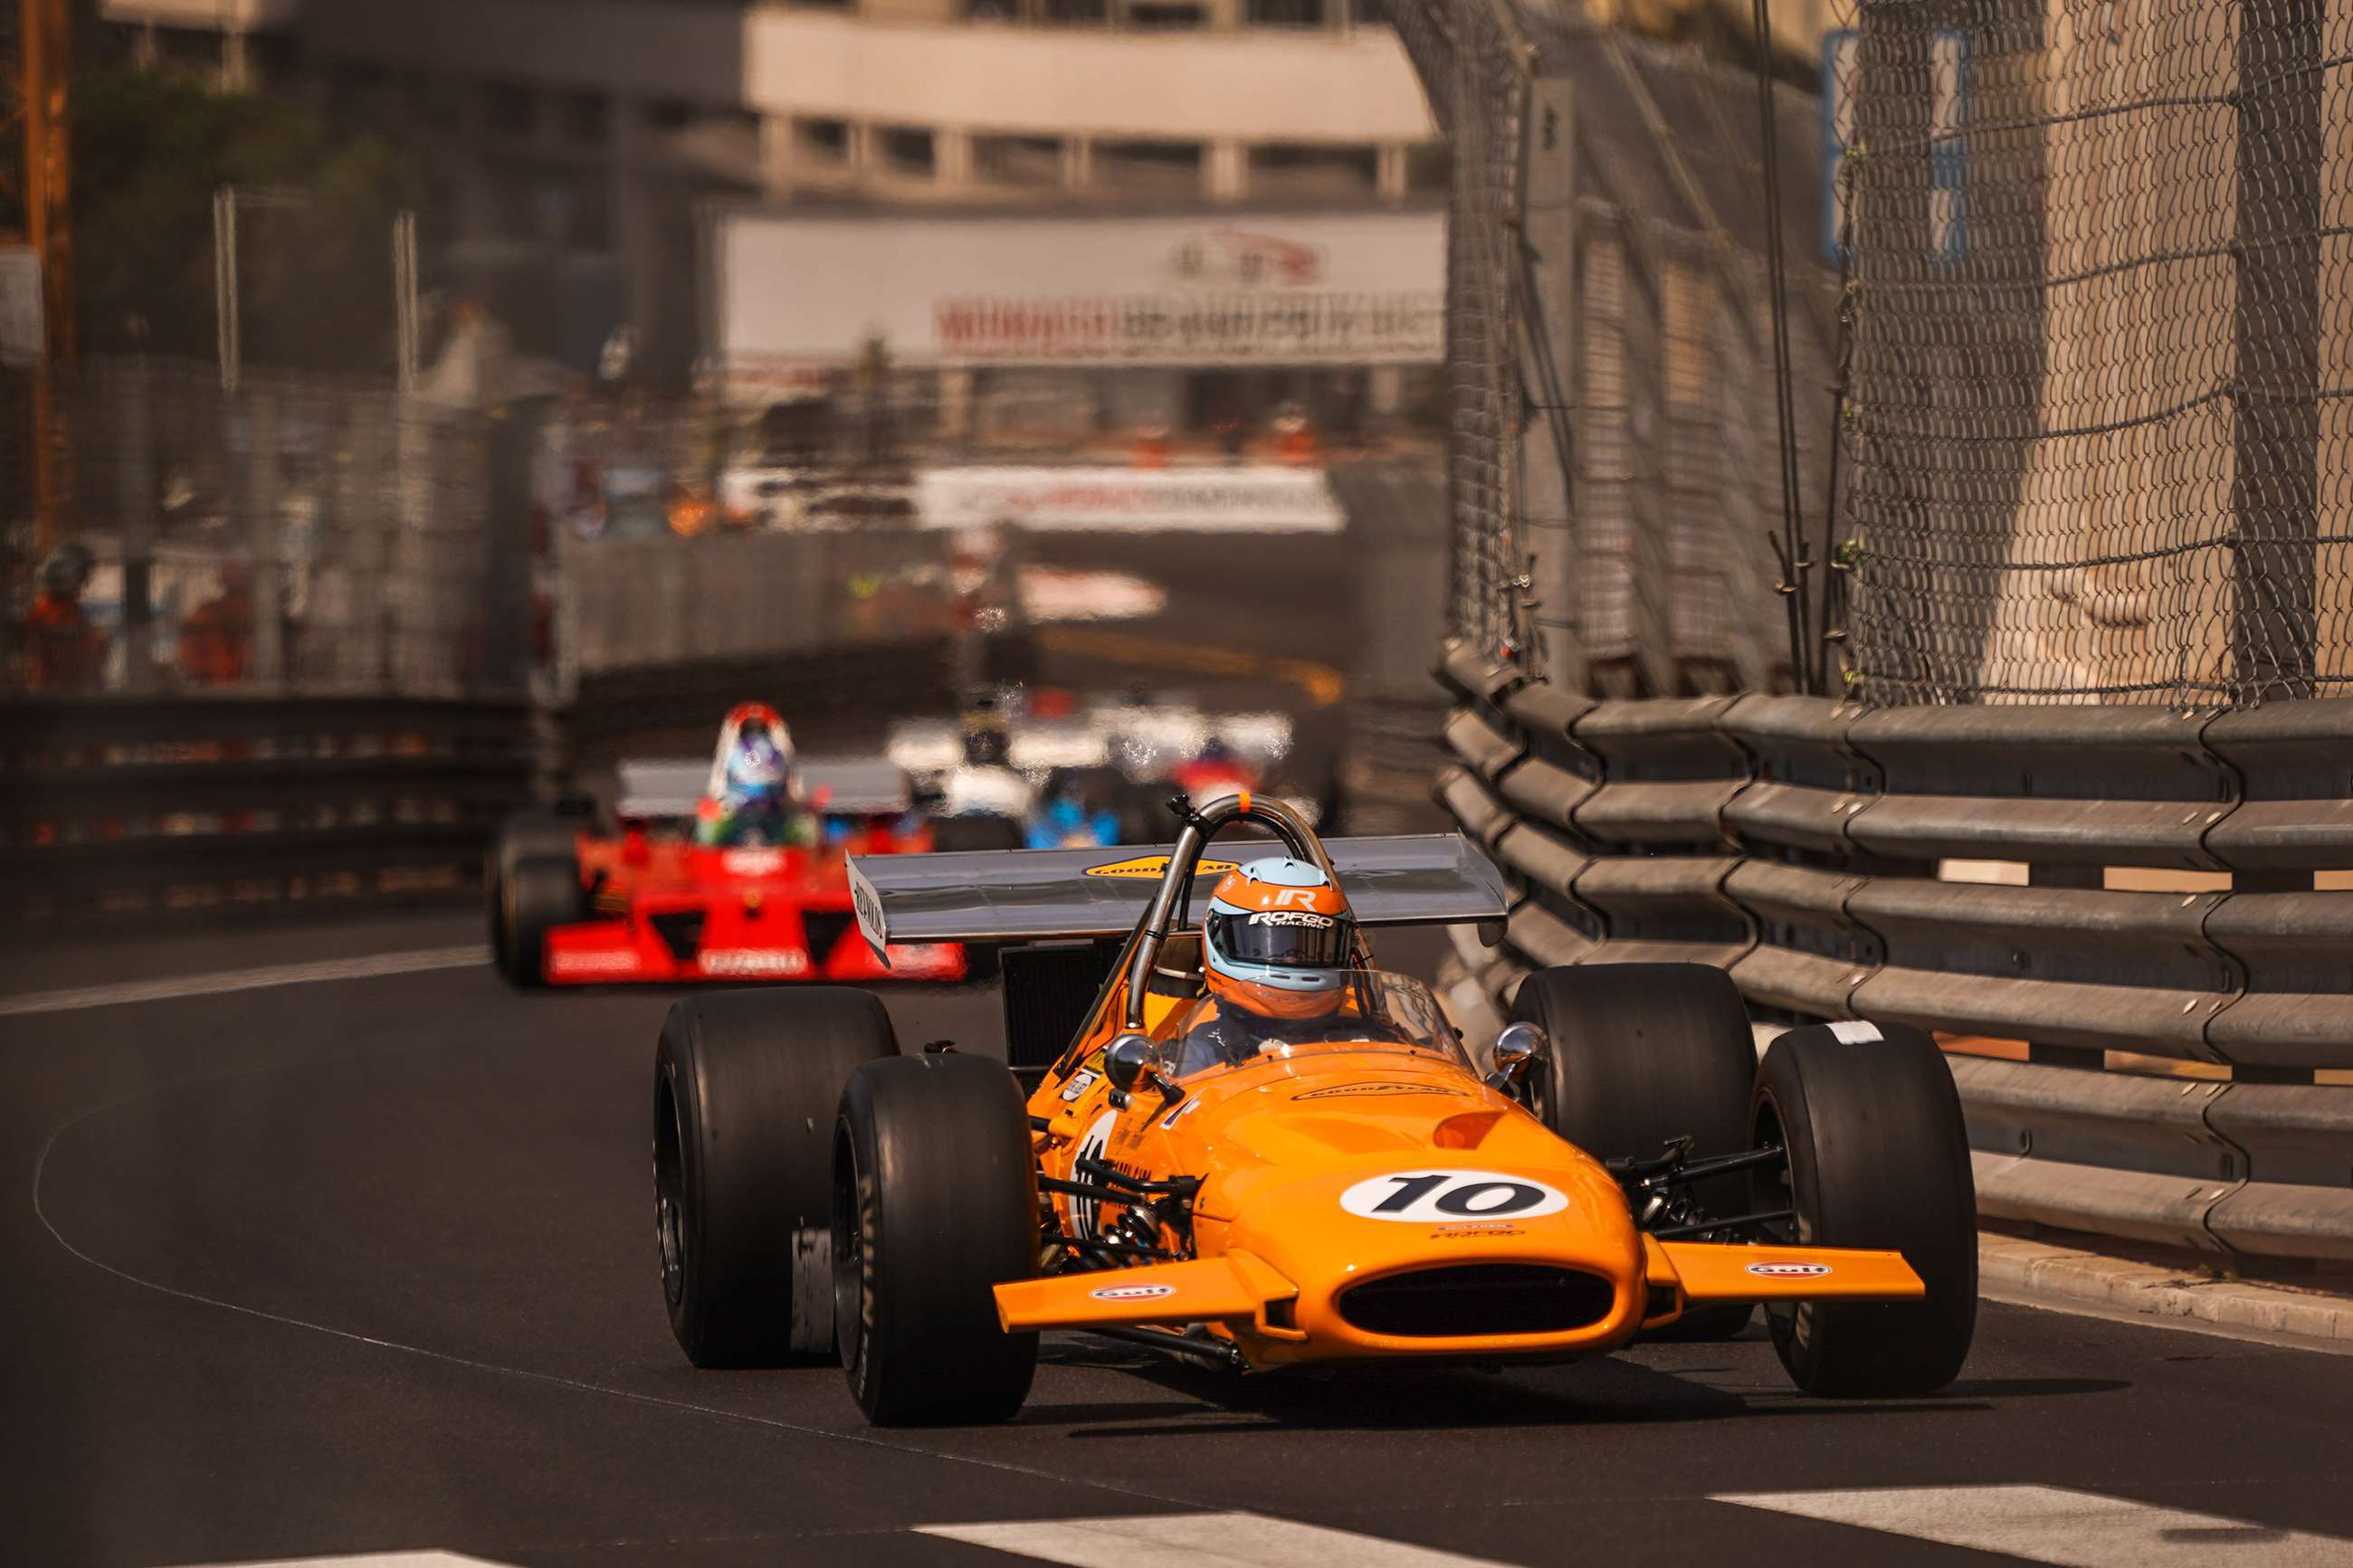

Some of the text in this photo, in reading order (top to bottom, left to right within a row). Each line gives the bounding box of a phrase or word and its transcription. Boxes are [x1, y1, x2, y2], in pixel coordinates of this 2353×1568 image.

[1094, 864, 1233, 875] GOODAR
[1275, 920, 1324, 929] RACING
[1371, 1174, 1546, 1217] 10
[1749, 1266, 1824, 1274] Gulf
